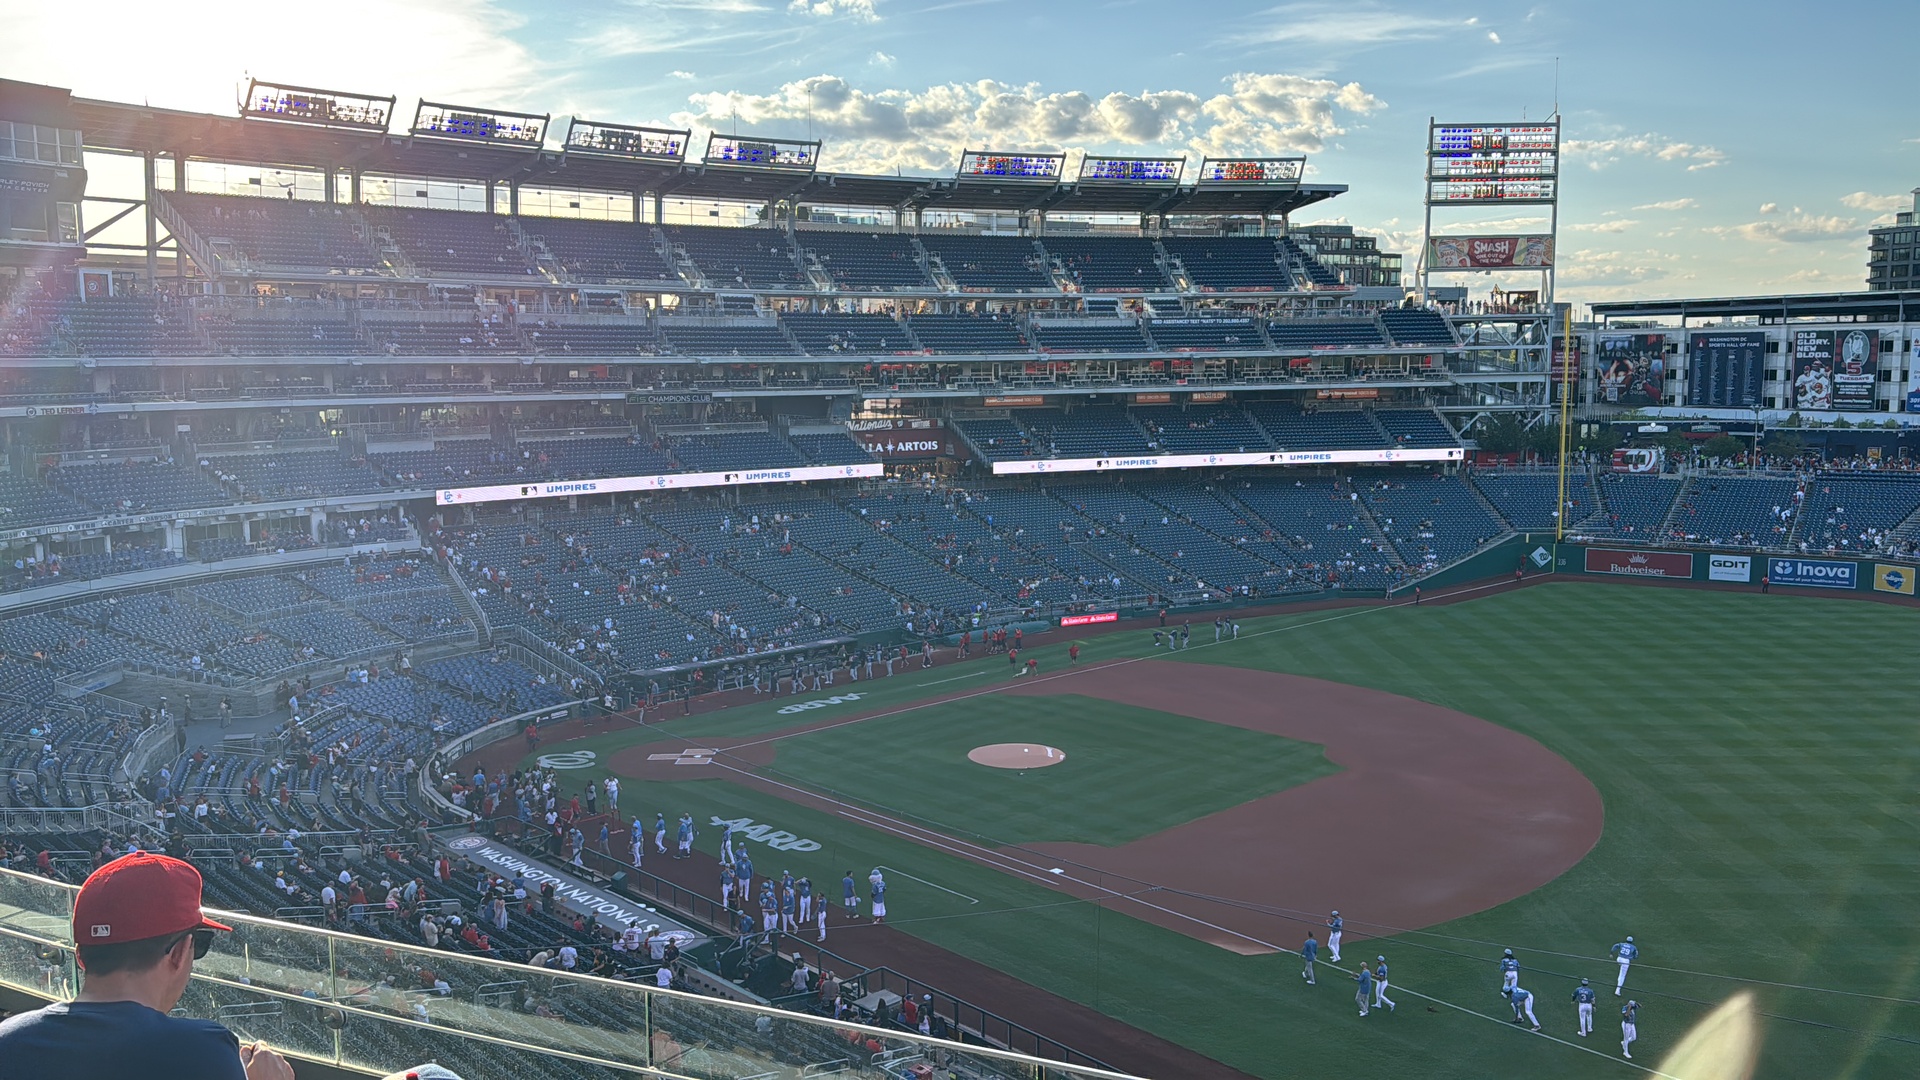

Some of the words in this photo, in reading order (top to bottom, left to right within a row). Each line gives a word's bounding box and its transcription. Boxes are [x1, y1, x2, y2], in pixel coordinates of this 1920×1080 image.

[1474, 241, 1509, 254] SMASH
[845, 419, 893, 431] Nationals
[897, 441, 938, 452] ARTOIS
[1290, 453, 1331, 461] UMPIRES
[746, 471, 791, 480] UMPIRES
[546, 483, 597, 493] UMPIRES
[1610, 563, 1664, 574] Budweiser
[1711, 559, 1749, 569] GDIT
[1797, 562, 1850, 578] Inova
[709, 815, 822, 852] AARP
[475, 846, 574, 892] WASHINGTON
[563, 888, 660, 933] NATIONALS
[1620, 947, 1631, 956] 29
